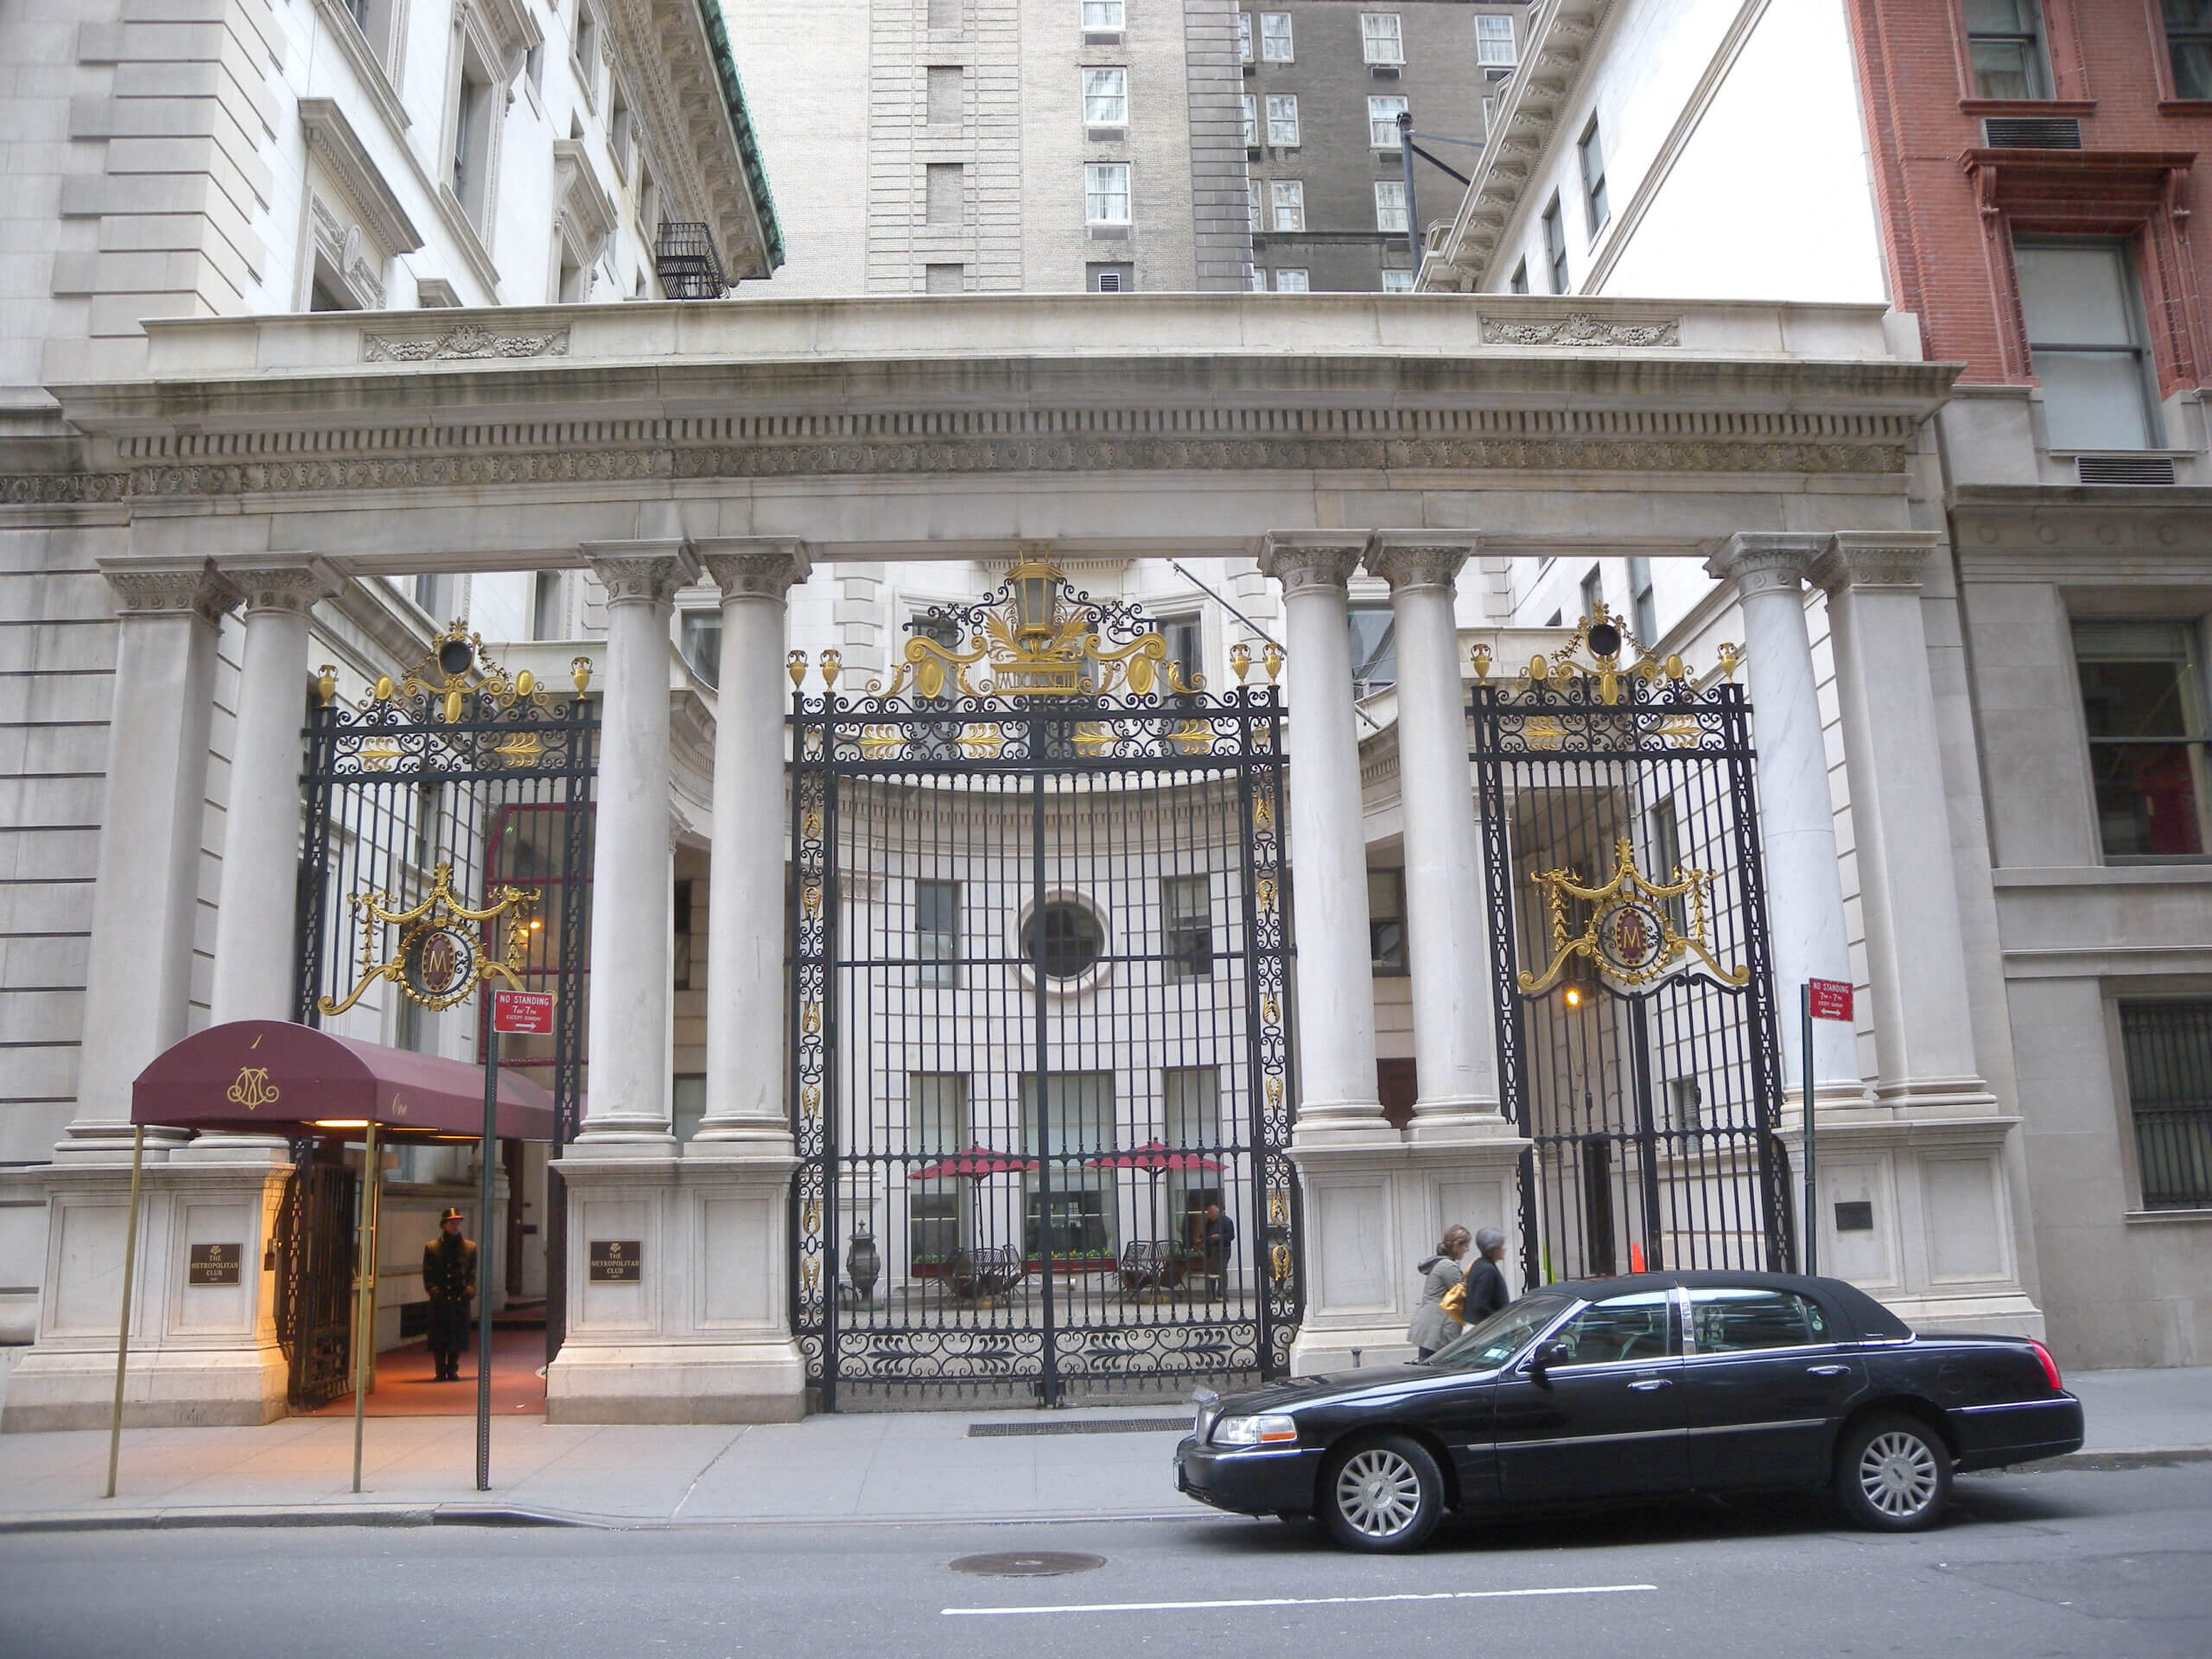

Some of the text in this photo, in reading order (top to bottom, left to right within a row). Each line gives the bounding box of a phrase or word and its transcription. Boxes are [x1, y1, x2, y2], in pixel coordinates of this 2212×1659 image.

[1624, 925, 1641, 949] M
[429, 950, 448, 973] M
[1813, 981, 1849, 994] NO STANDING
[499, 995, 550, 1007] NO STANDING
[392, 1092, 409, 1116] One
